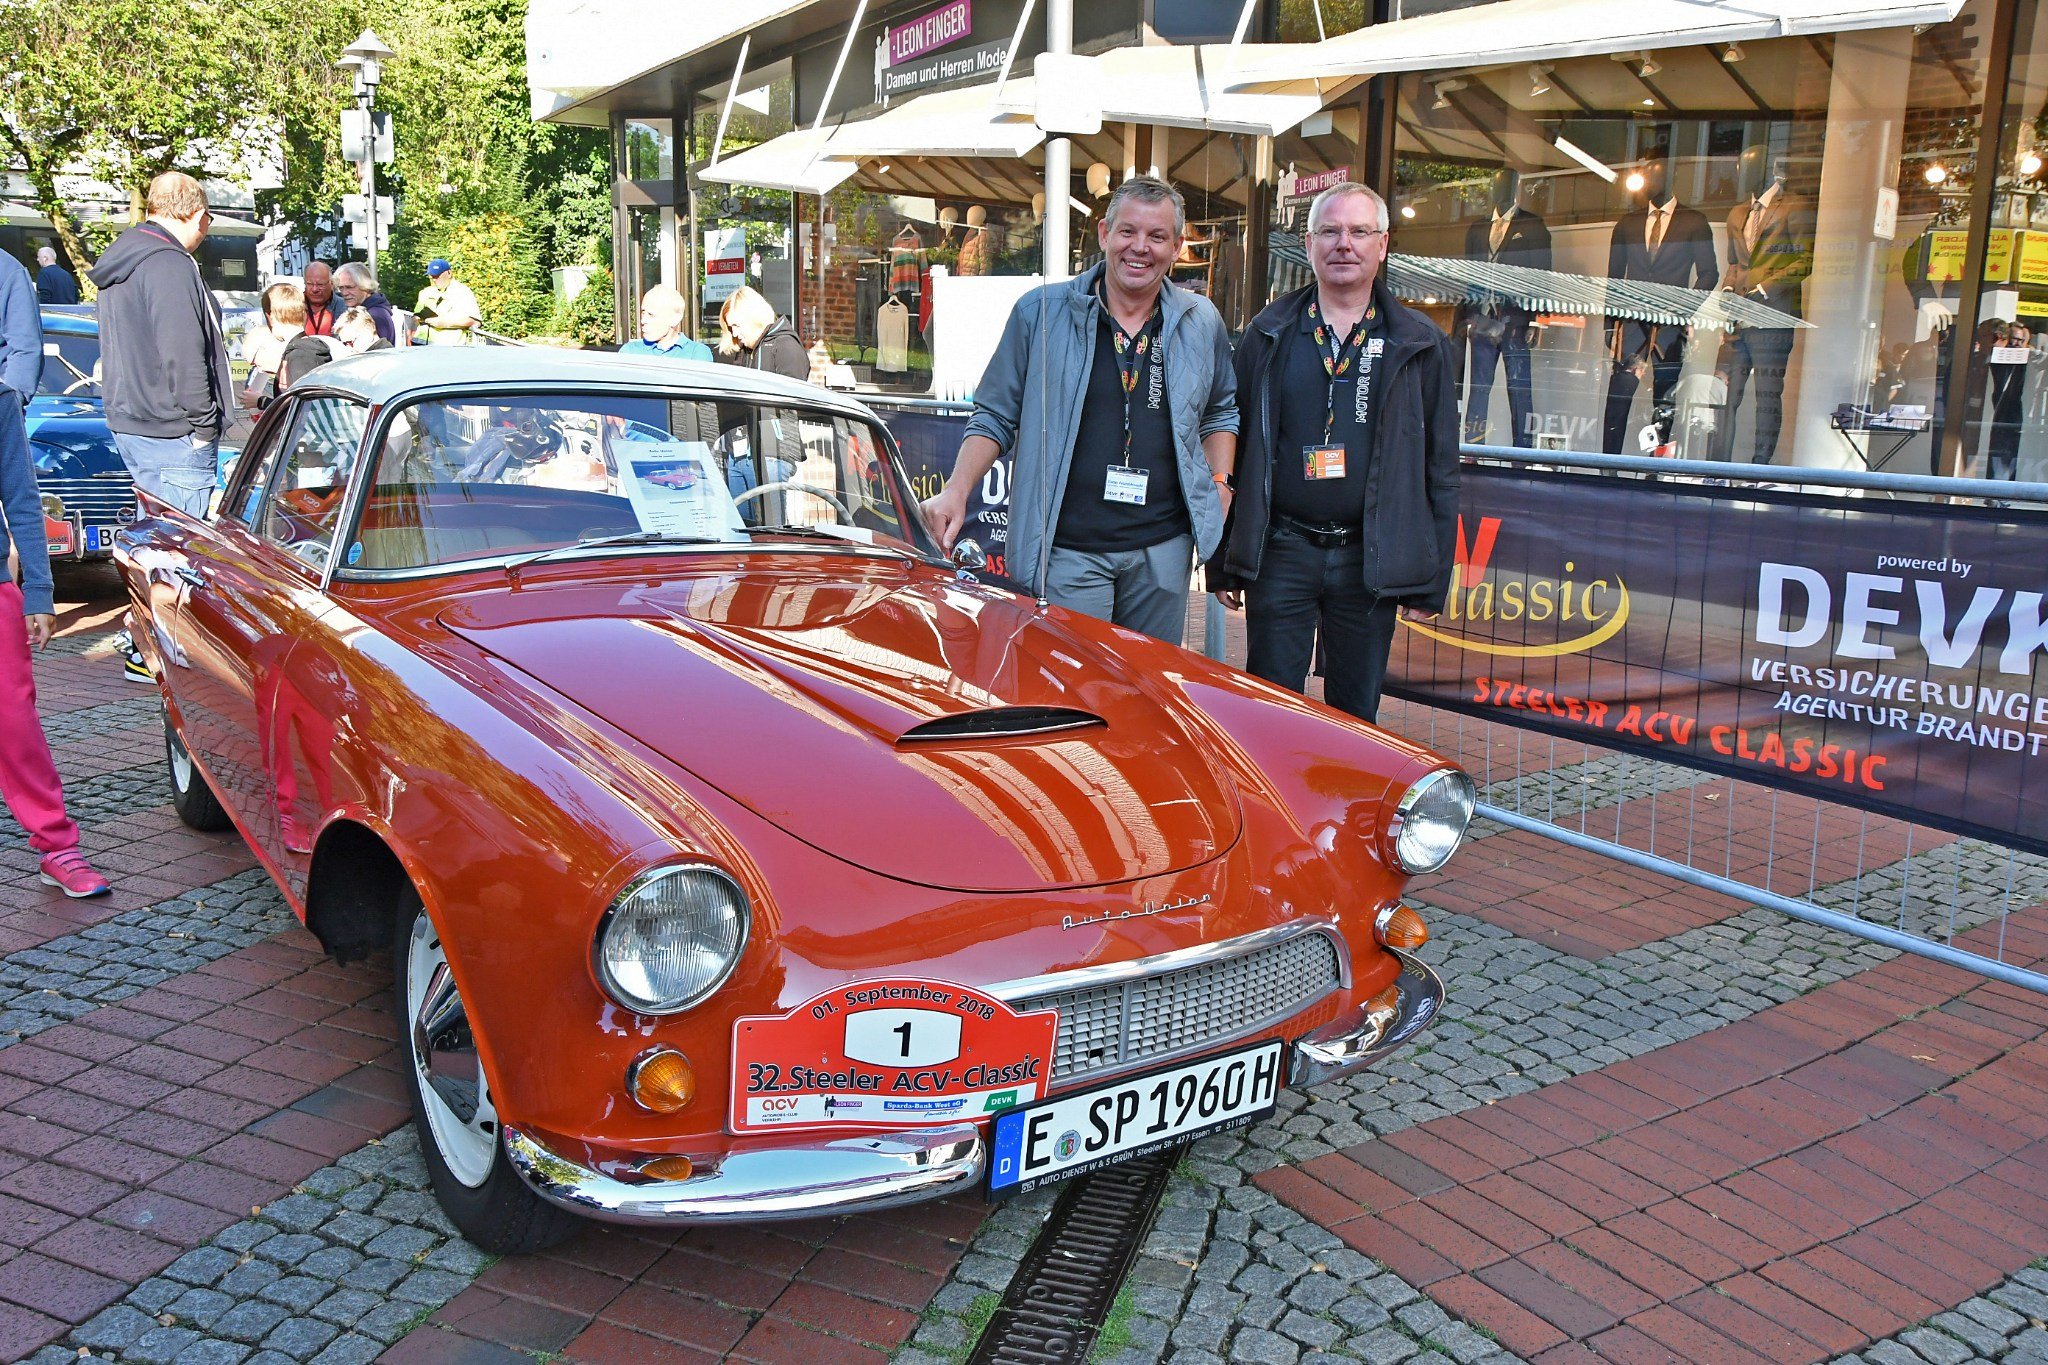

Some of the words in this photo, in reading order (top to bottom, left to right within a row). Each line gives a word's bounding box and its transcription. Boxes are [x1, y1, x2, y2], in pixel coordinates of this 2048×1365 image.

[897, 22, 923, 58] LEON
[926, 3, 966, 46] FINGER
[886, 72, 917, 90] Damen
[920, 61, 938, 82] und
[940, 58, 974, 79] Herren
[977, 47, 1007, 71] Mode
[1300, 179, 1318, 193] LEON
[1320, 169, 1347, 188] FINGER
[1359, 346, 1373, 374] OILS
[1148, 364, 1163, 410] MOTOR
[1355, 375, 1371, 424] MOTOR
[1876, 554, 1947, 572] powered
[1951, 558, 1972, 579] by
[1442, 561, 1609, 621] lassic
[1755, 561, 2048, 676] DEVK
[1472, 676, 1609, 728] STEELER
[1615, 705, 1697, 745] ACV
[1708, 725, 1888, 792] CLASSIC
[1773, 690, 1909, 731] AGENTUR
[1915, 711, 2048, 756] BRANDT
[812, 1000, 839, 1020] 01.
[845, 985, 951, 1006] September
[956, 995, 995, 1021] 2018
[893, 1022, 911, 1057] 1
[891, 1052, 1041, 1092] ACV-Classic
[887, 1102, 933, 1110] Sparda-Bank
[991, 1095, 1013, 1106] DEVK
[1025, 1111, 1054, 1171] E
[1039, 1171, 1060, 1187] AUTO
[1061, 1164, 1088, 1180] DIENST
[1089, 1161, 1098, 1171] W
[1105, 1158, 1111, 1166] S
[1111, 1150, 1134, 1164] GRÜN
[1136, 1143, 1163, 1157] Steeler
[1163, 1139, 1175, 1149] Str.
[1176, 1133, 1191, 1145] 477
[1191, 1129, 1211, 1140] Essen
[1000, 1157, 1011, 1175] D
